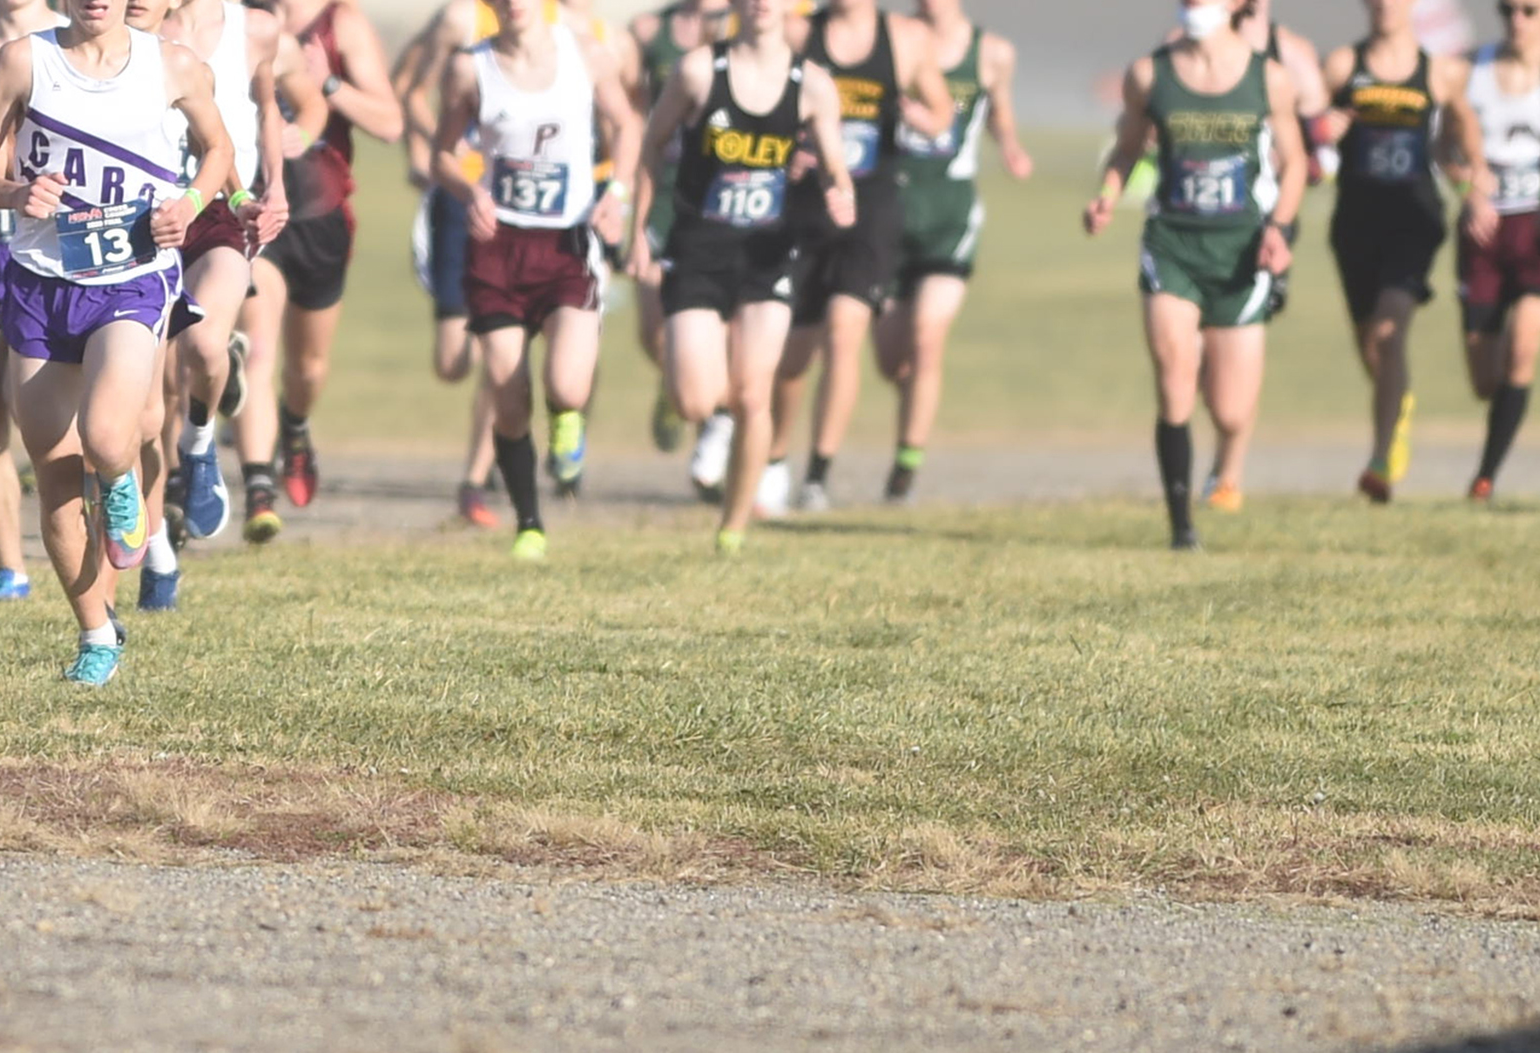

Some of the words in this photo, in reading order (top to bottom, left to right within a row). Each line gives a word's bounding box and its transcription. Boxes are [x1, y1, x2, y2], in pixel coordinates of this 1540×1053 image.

[530, 121, 562, 157] P
[502, 176, 561, 210] 137
[718, 189, 772, 219] 110
[1183, 176, 1234, 208] 121
[84, 228, 133, 266] 13
